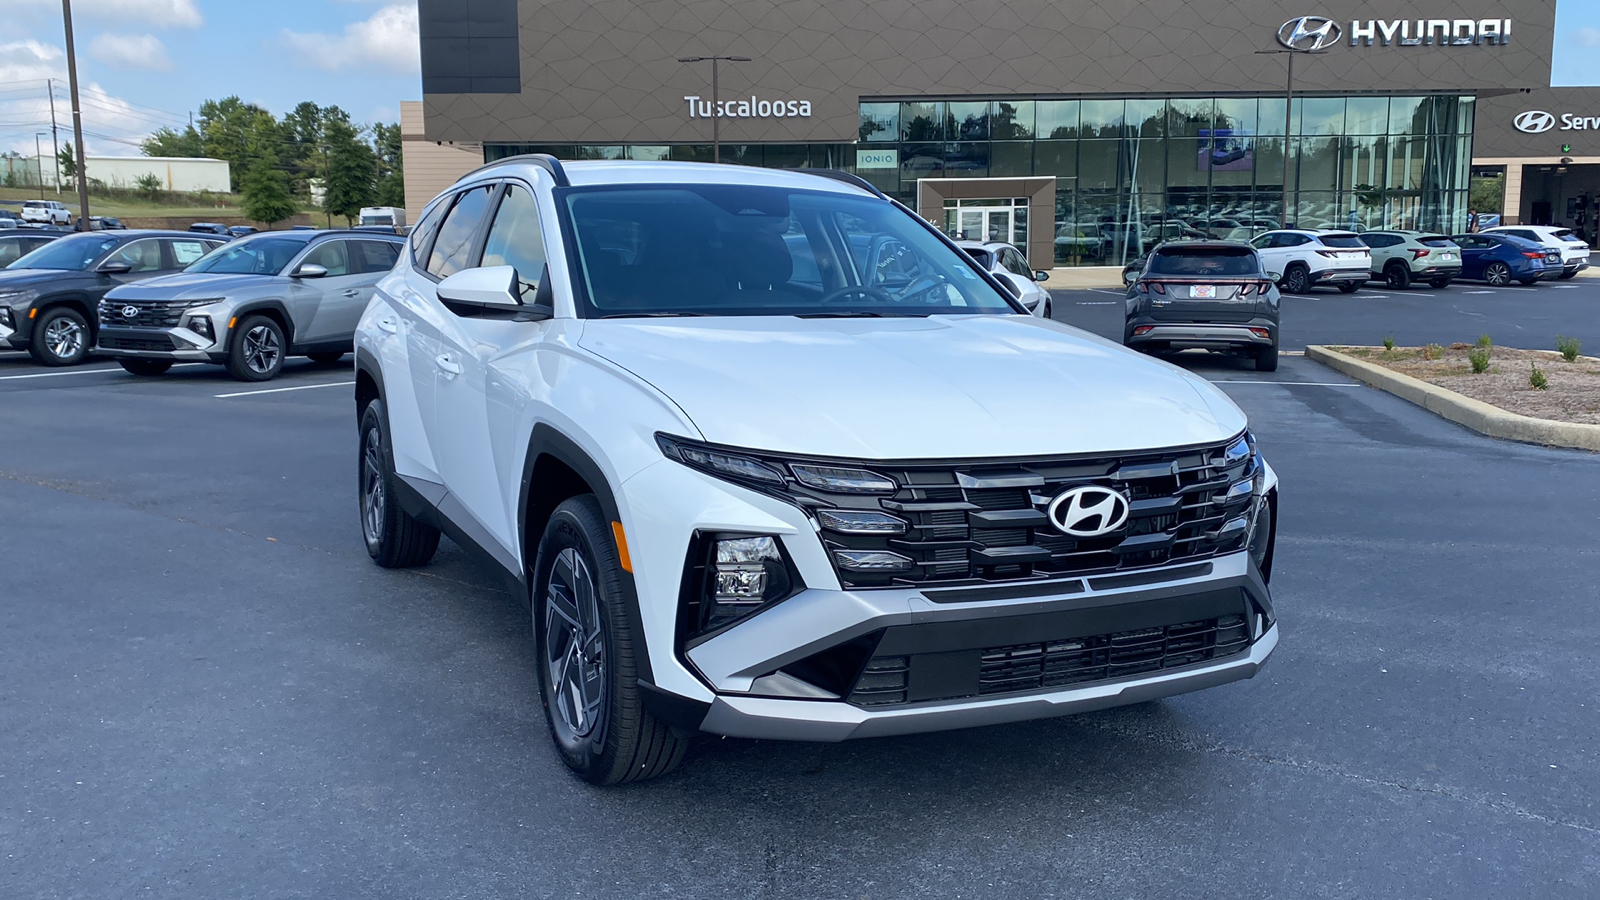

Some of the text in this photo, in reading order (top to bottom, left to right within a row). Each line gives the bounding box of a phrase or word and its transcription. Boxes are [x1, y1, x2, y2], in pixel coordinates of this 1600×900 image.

[1350, 19, 1512, 46] HYUNDAI
[683, 95, 812, 117] Tuscaloosa
[861, 155, 893, 163] IONIQ
